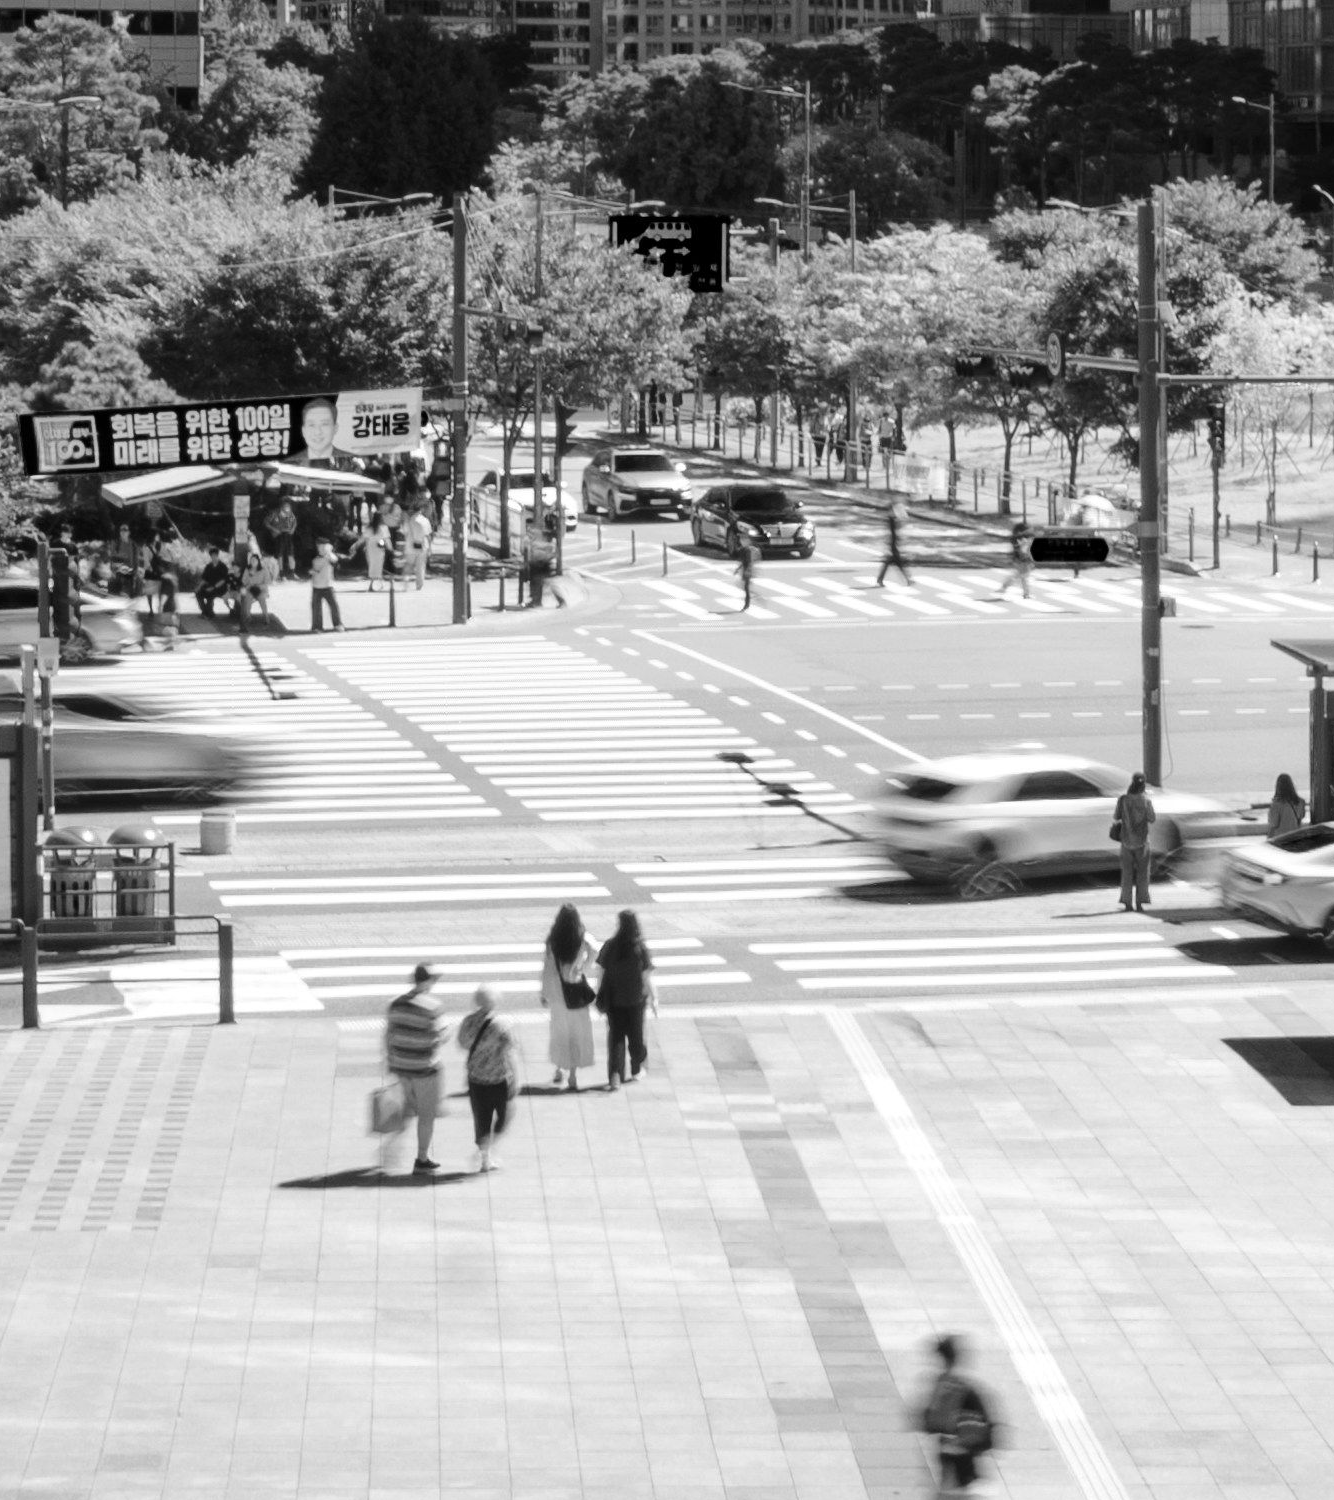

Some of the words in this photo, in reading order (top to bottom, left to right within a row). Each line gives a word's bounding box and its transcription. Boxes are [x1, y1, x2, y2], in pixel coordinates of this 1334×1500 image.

[110, 411, 179, 439] 회복을
[185, 408, 230, 434] 위한
[235, 404, 291, 431] 100일
[352, 413, 410, 438] 강태웅
[114, 437, 180, 465] 미래를
[187, 434, 232, 461] 위한
[238, 430, 290, 458] 성장!
